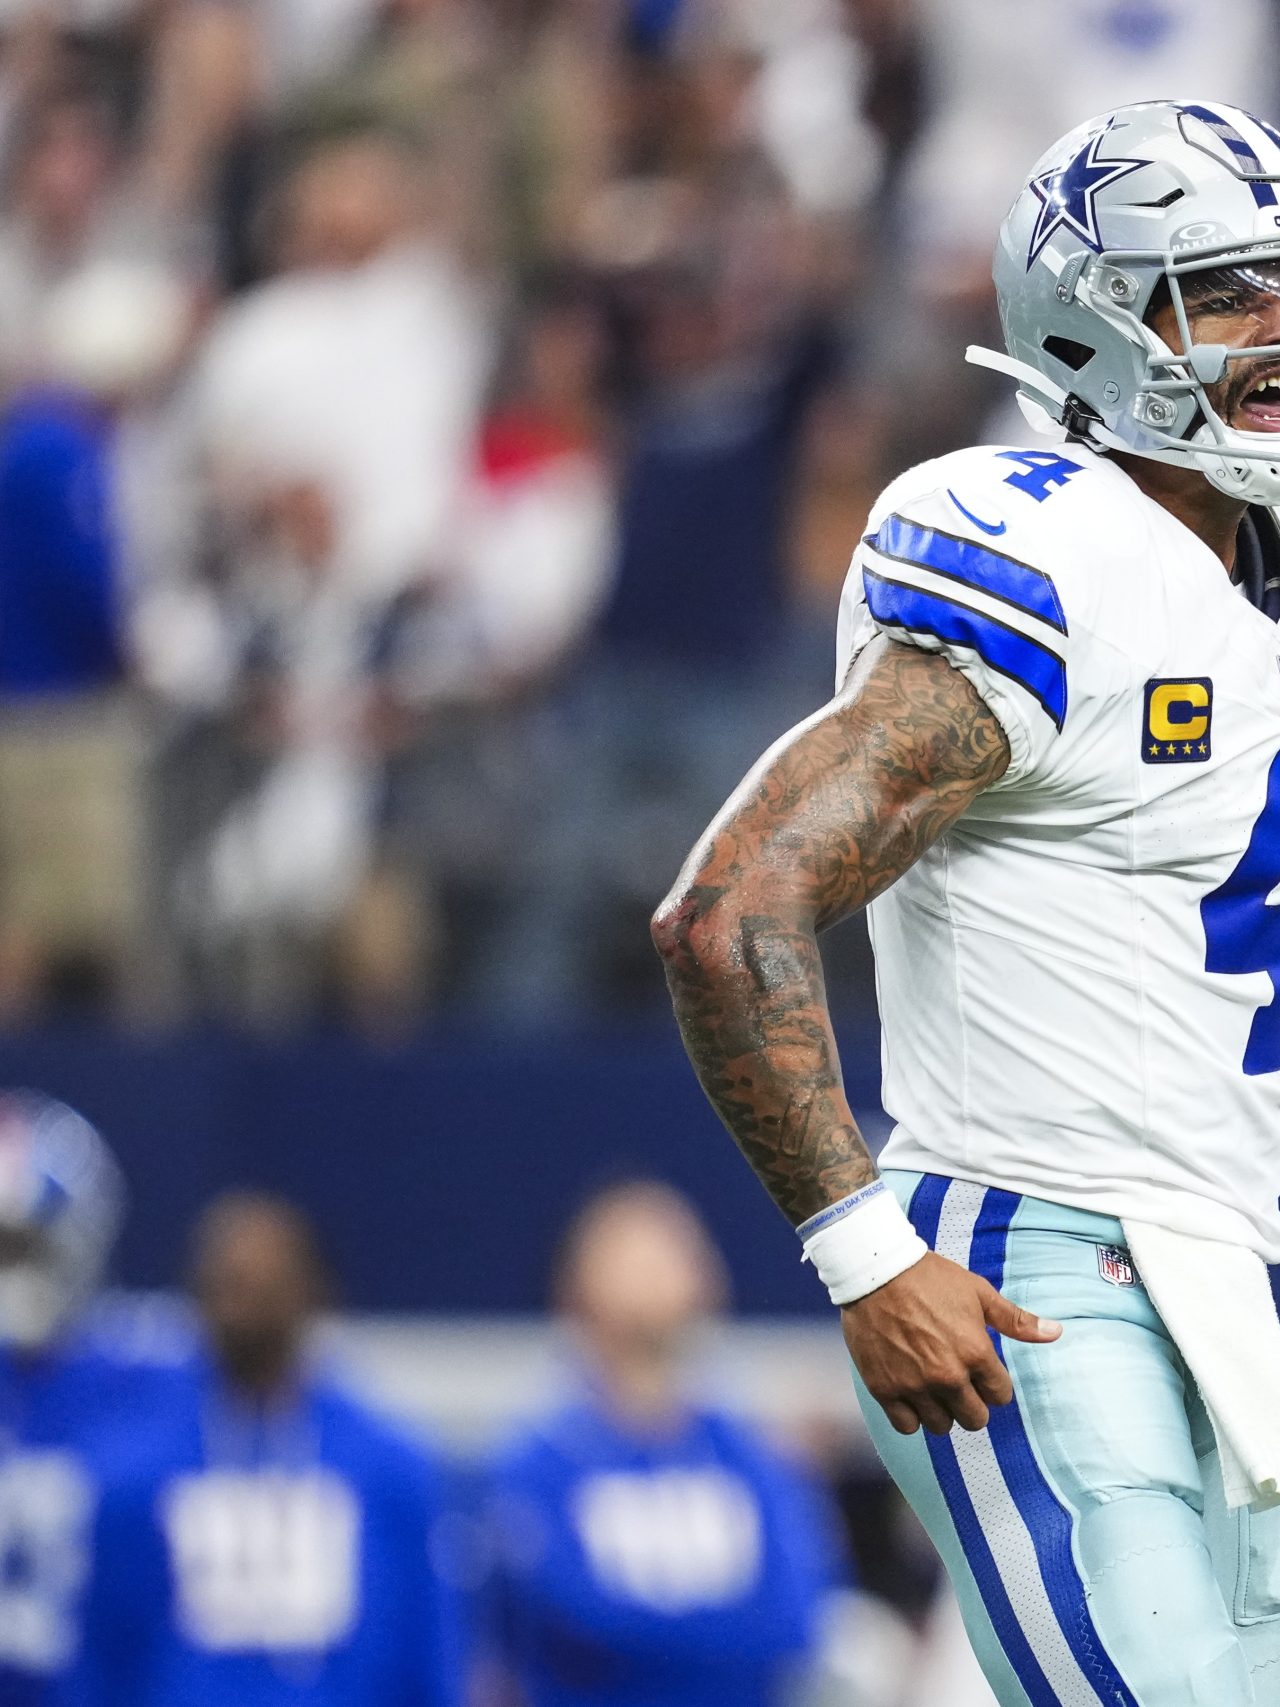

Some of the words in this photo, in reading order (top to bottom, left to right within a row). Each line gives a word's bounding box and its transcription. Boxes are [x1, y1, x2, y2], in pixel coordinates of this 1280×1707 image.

[1172, 235, 1226, 251] OAKLEY
[994, 450, 1088, 504] 4
[1149, 683, 1209, 741] C
[835, 1204, 846, 1214] by
[844, 1196, 861, 1209] DAK
[1105, 1260, 1131, 1280] NFL
